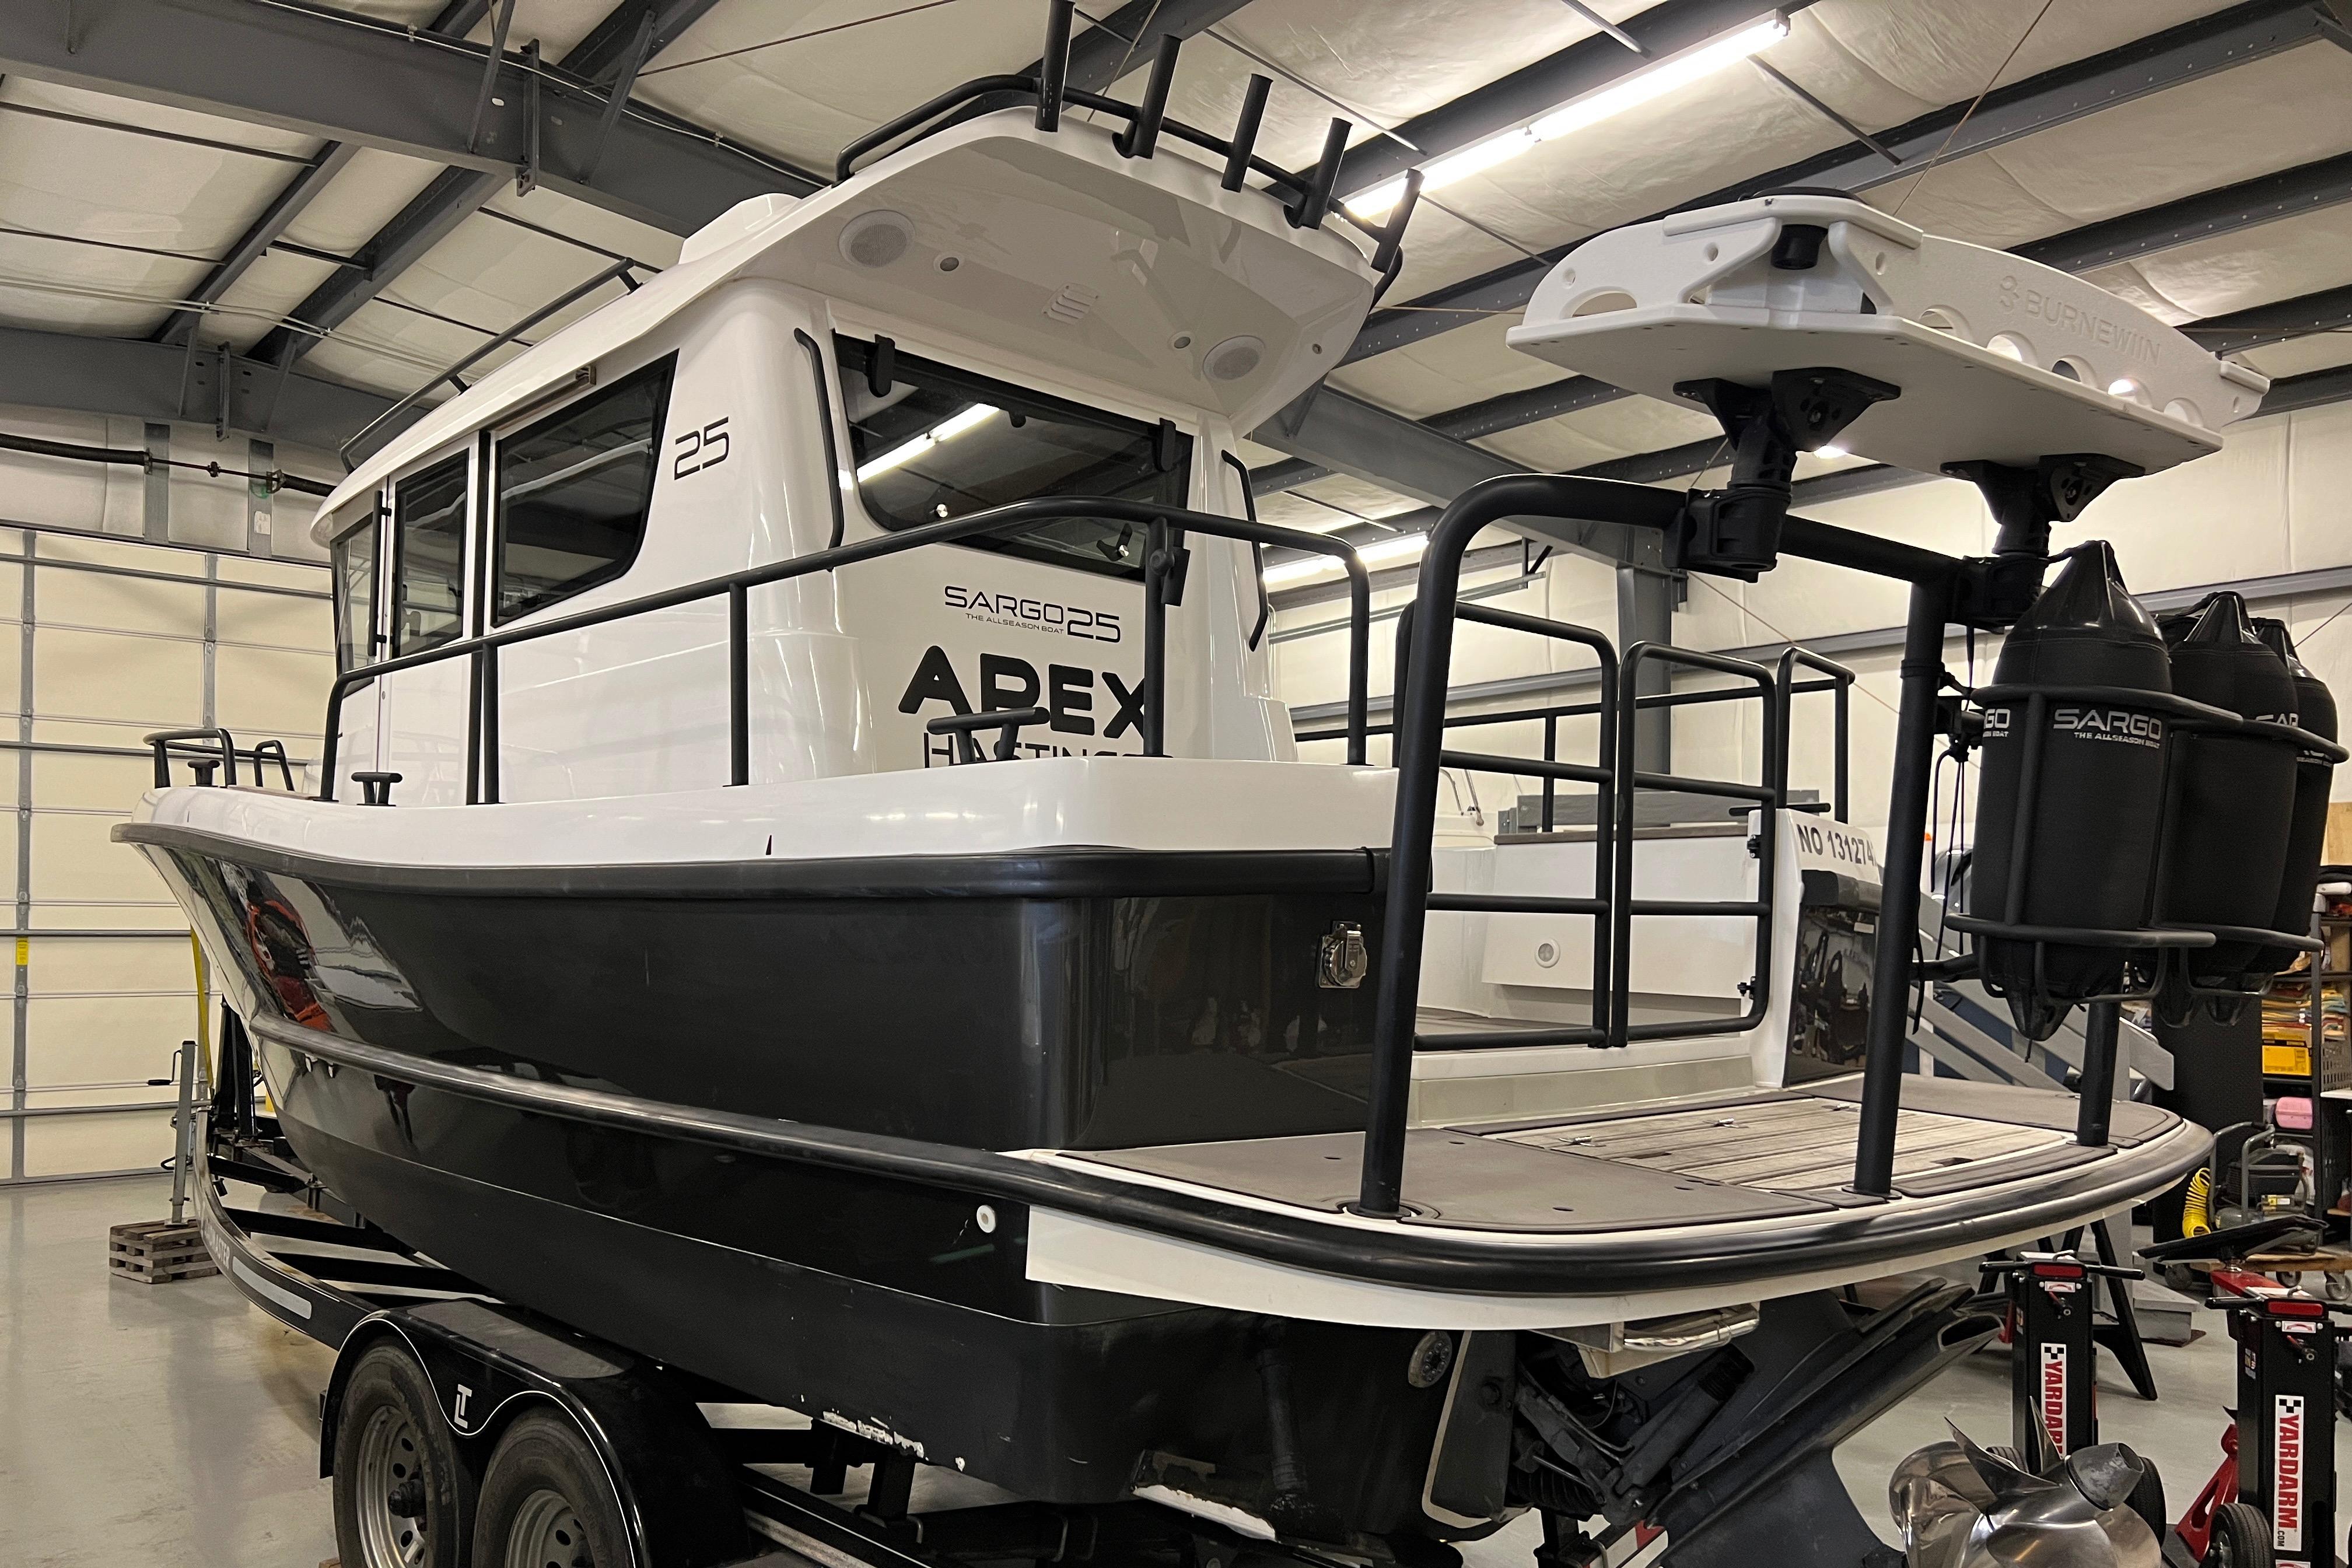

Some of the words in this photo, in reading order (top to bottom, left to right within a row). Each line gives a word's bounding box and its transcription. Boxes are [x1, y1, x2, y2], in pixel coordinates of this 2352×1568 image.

[674, 416, 729, 481] 25
[965, 612, 984, 621] THE
[986, 616, 1040, 630] ALLSEASON
[1041, 625, 1064, 634] BOAT
[898, 645, 1145, 740] APEX
[2053, 708, 2162, 740] SARGO
[1796, 823, 1823, 856] NO
